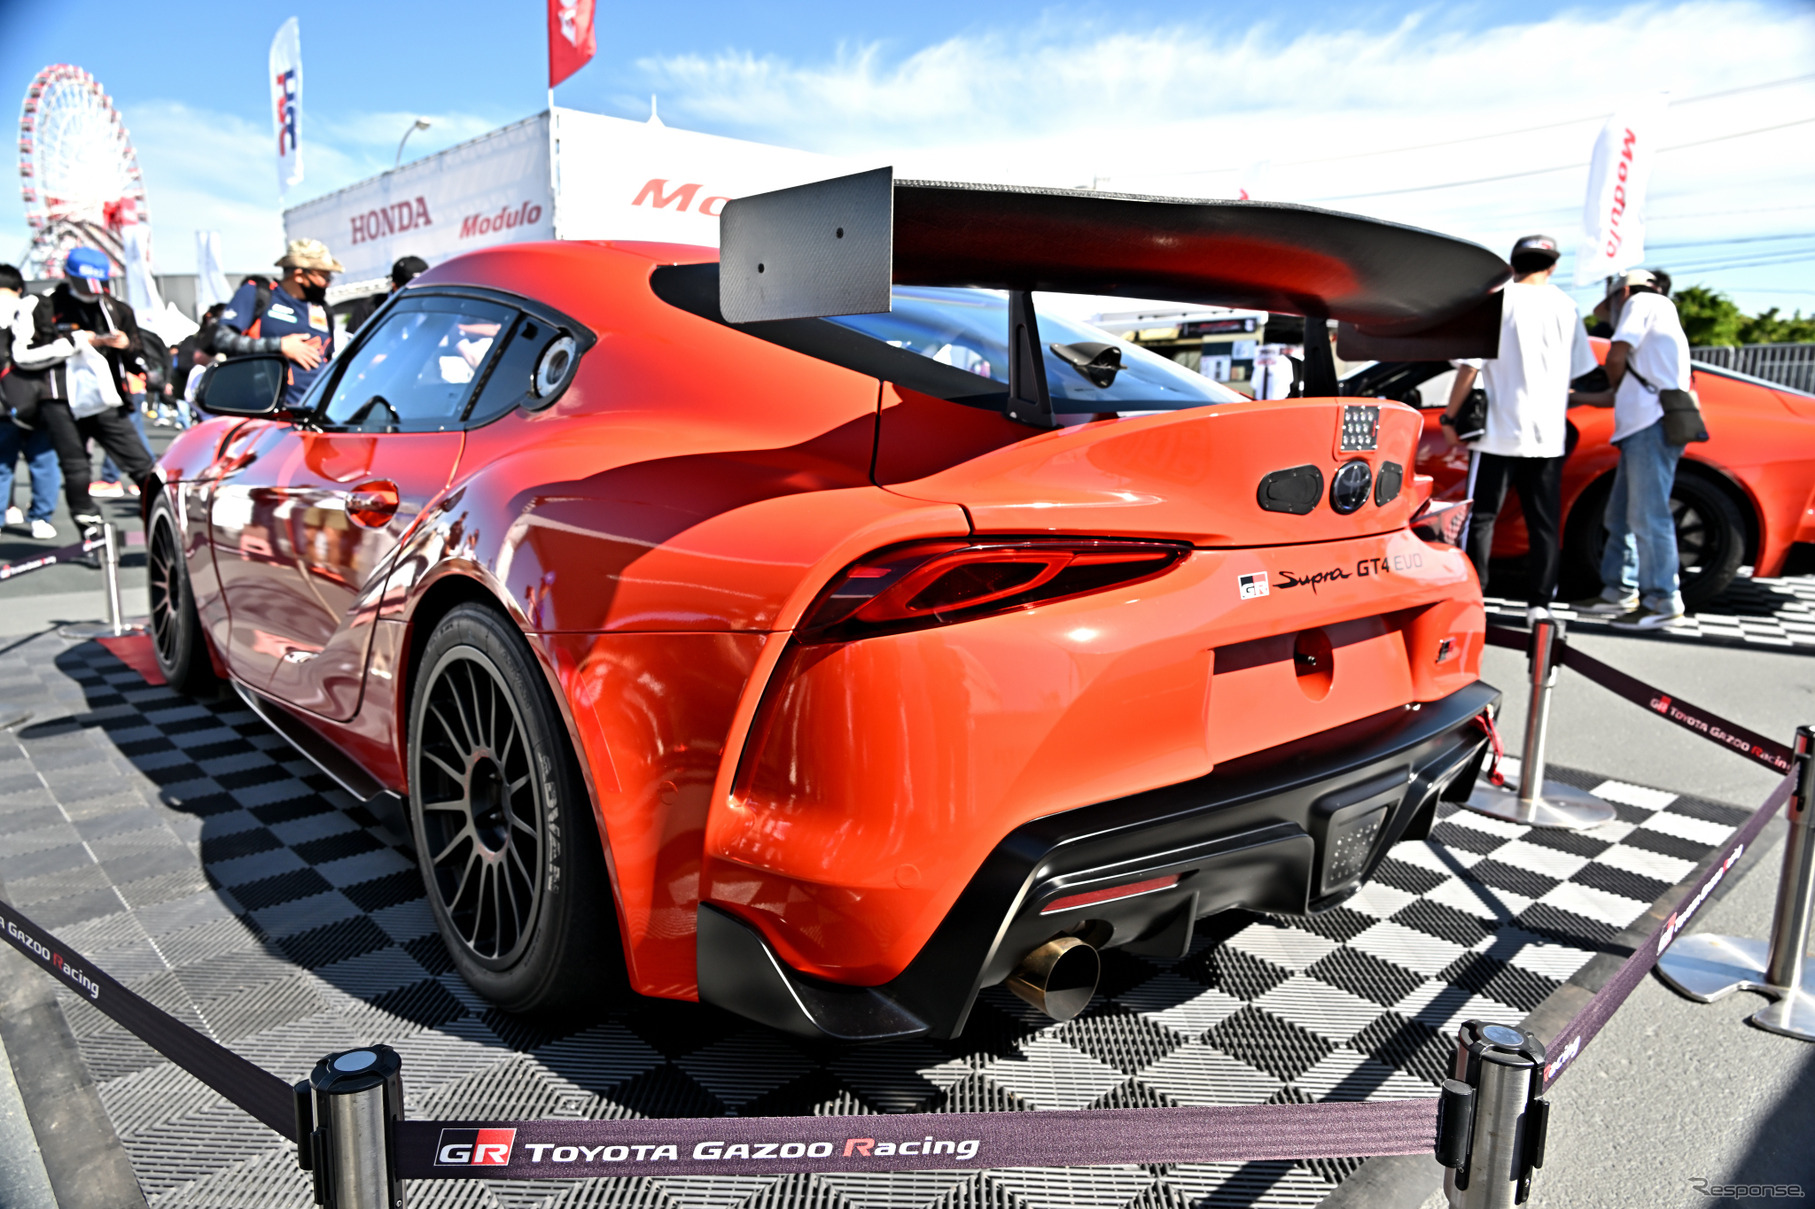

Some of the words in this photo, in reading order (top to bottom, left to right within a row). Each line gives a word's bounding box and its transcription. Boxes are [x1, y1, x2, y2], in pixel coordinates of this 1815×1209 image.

[1605, 127, 1636, 258] Modulo
[350, 195, 432, 245] HONDA
[459, 200, 542, 239] Modulo
[1272, 567, 1352, 595] Supra
[1357, 557, 1390, 577] GT4
[1393, 553, 1423, 571] EVO
[538, 752, 561, 894] ADVAN
[7, 921, 51, 961] GAZOO
[53, 951, 99, 999] Racing
[524, 1143, 678, 1163] TOYOTA
[692, 1141, 833, 1160] GAZOO
[842, 1135, 980, 1160] Racing
